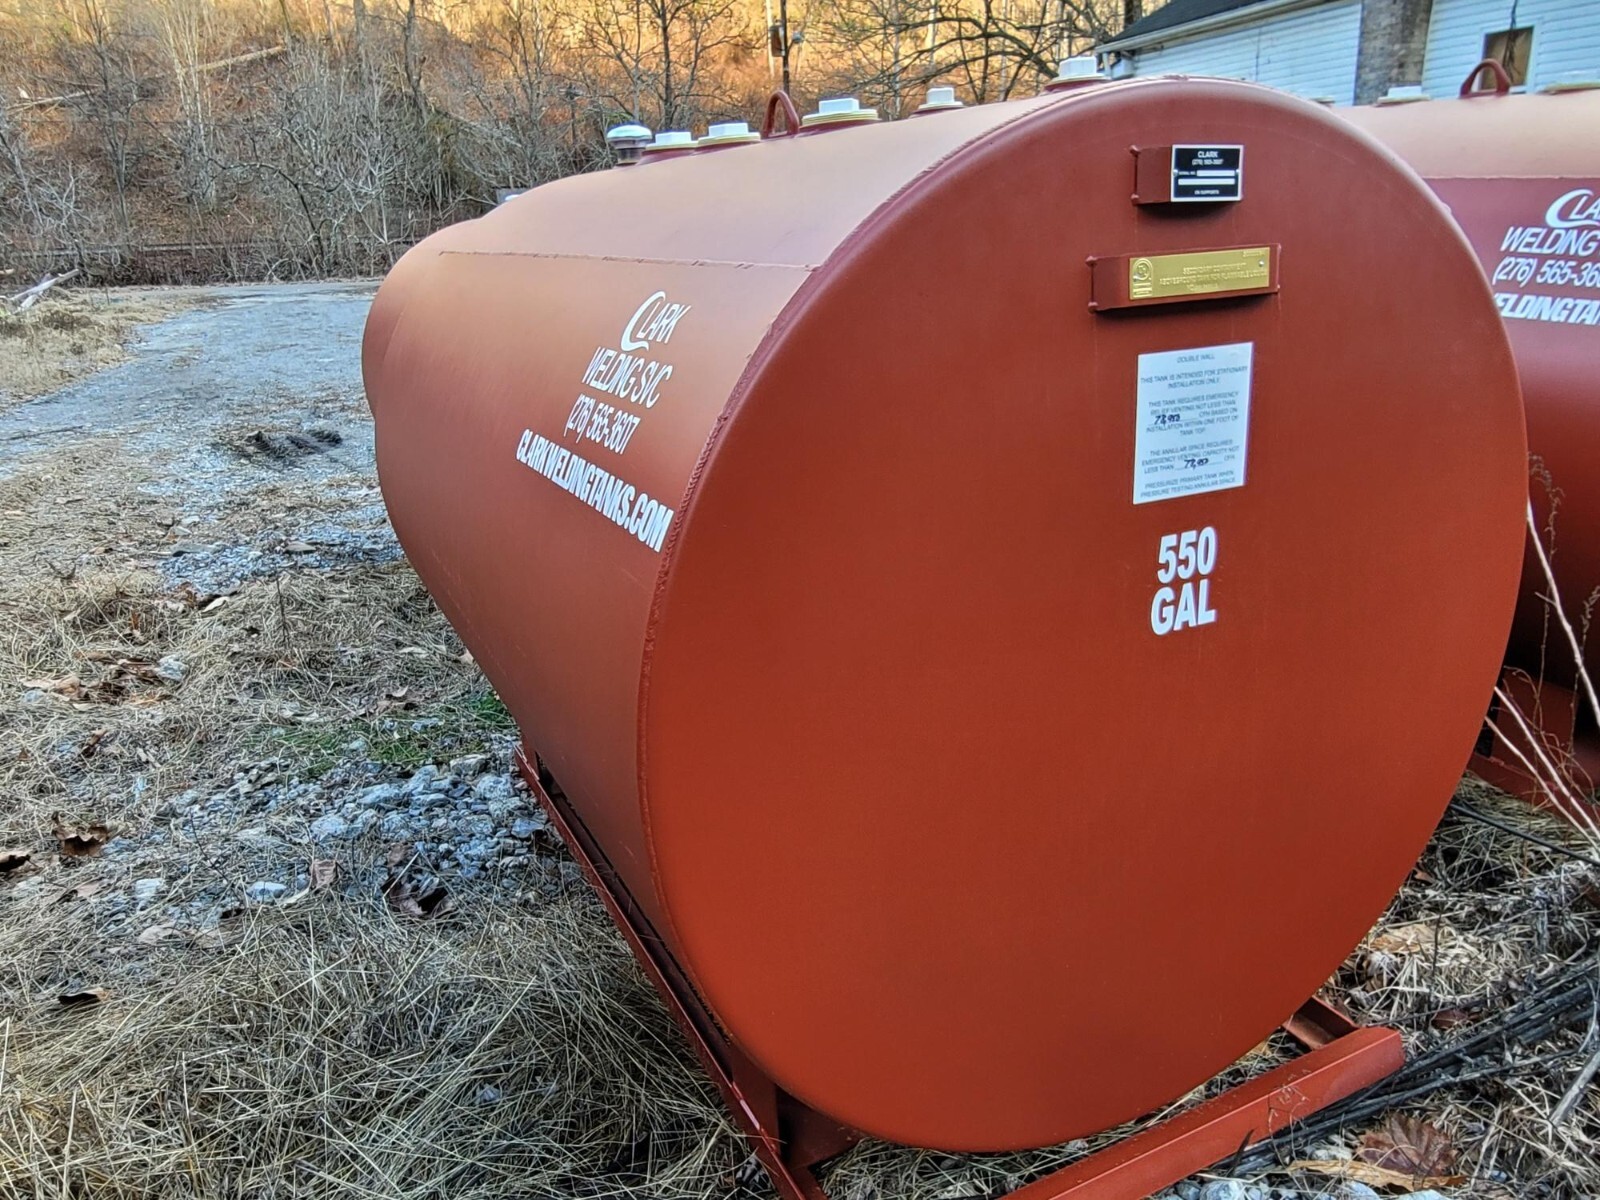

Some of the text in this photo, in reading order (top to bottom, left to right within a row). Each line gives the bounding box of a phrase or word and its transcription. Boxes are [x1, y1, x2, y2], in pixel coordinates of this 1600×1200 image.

[1545, 189, 1600, 228] CLA
[1501, 226, 1600, 257] WELDING
[1492, 256, 1538, 288] (276)
[1494, 292, 1600, 325] ELDINGTA
[620, 291, 691, 352] CLARK
[581, 346, 673, 409] WELDING SVC
[1175, 371, 1203, 380] INTENDED
[1216, 365, 1248, 375] STATIONARY
[1168, 379, 1205, 389] INSTALLATION
[1177, 395, 1205, 404] REQUIRES
[1206, 391, 1240, 400] EMERGENCY
[1170, 405, 1195, 413] VENTING
[1211, 408, 1229, 416] BASED
[563, 393, 641, 455] (276) 565-3607
[1216, 415, 1230, 423] FOOT
[1142, 456, 1176, 466] EMERGENCY
[1202, 447, 1227, 457] CAPACITY
[1162, 446, 1187, 455] ANNULAR
[1206, 439, 1233, 448] REQUIRES
[1144, 466, 1158, 474] LESS
[1180, 474, 1203, 482] PRIMARY
[515, 429, 675, 553] CLARKWELDINGTANKS.COM
[1140, 487, 1170, 497] PRESSURE
[1194, 480, 1218, 488] ANNULAR
[1157, 526, 1217, 584] 550
[1150, 578, 1218, 636] GAL
